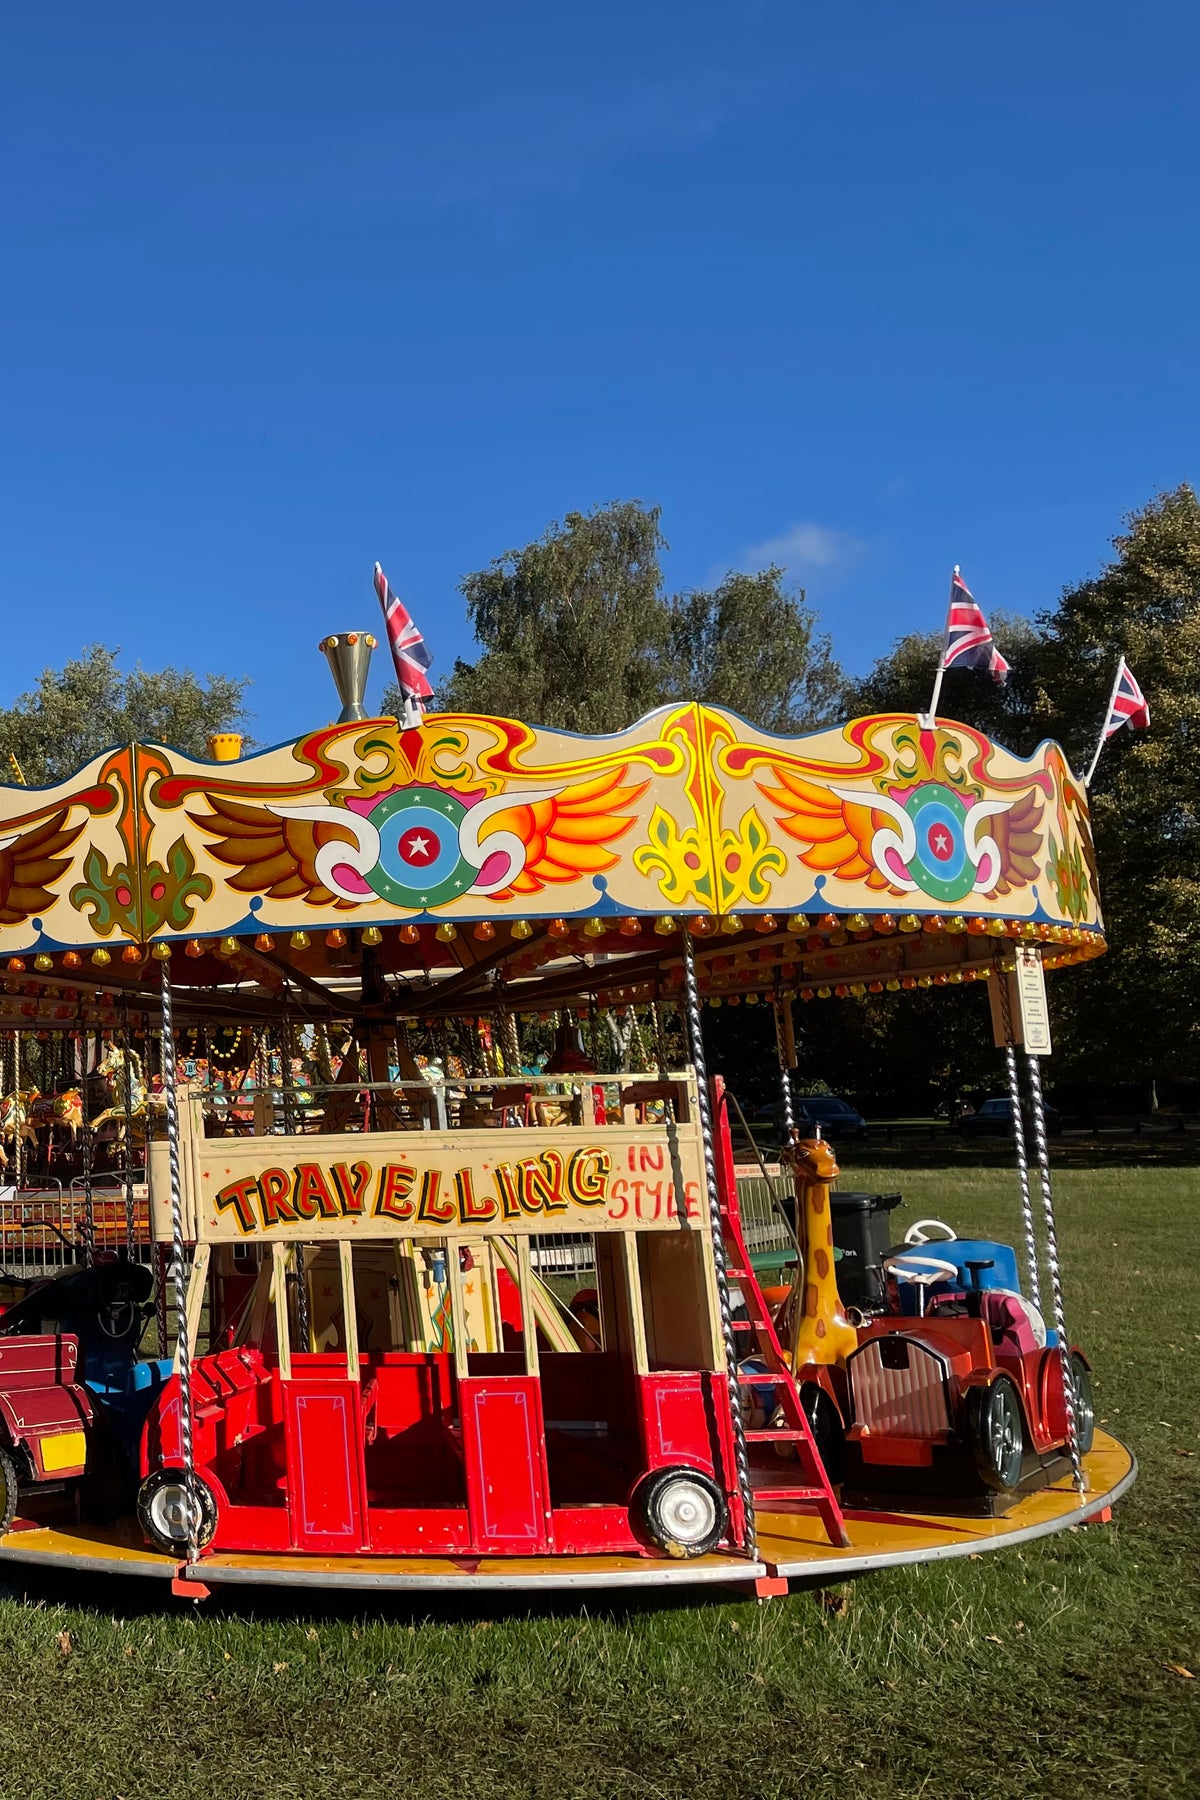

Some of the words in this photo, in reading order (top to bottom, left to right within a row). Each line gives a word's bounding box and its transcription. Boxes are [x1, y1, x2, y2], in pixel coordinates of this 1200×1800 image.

[628, 1145, 664, 1172] IN
[214, 1145, 612, 1235] TRAVELLING
[608, 1178, 700, 1220] STYLE
